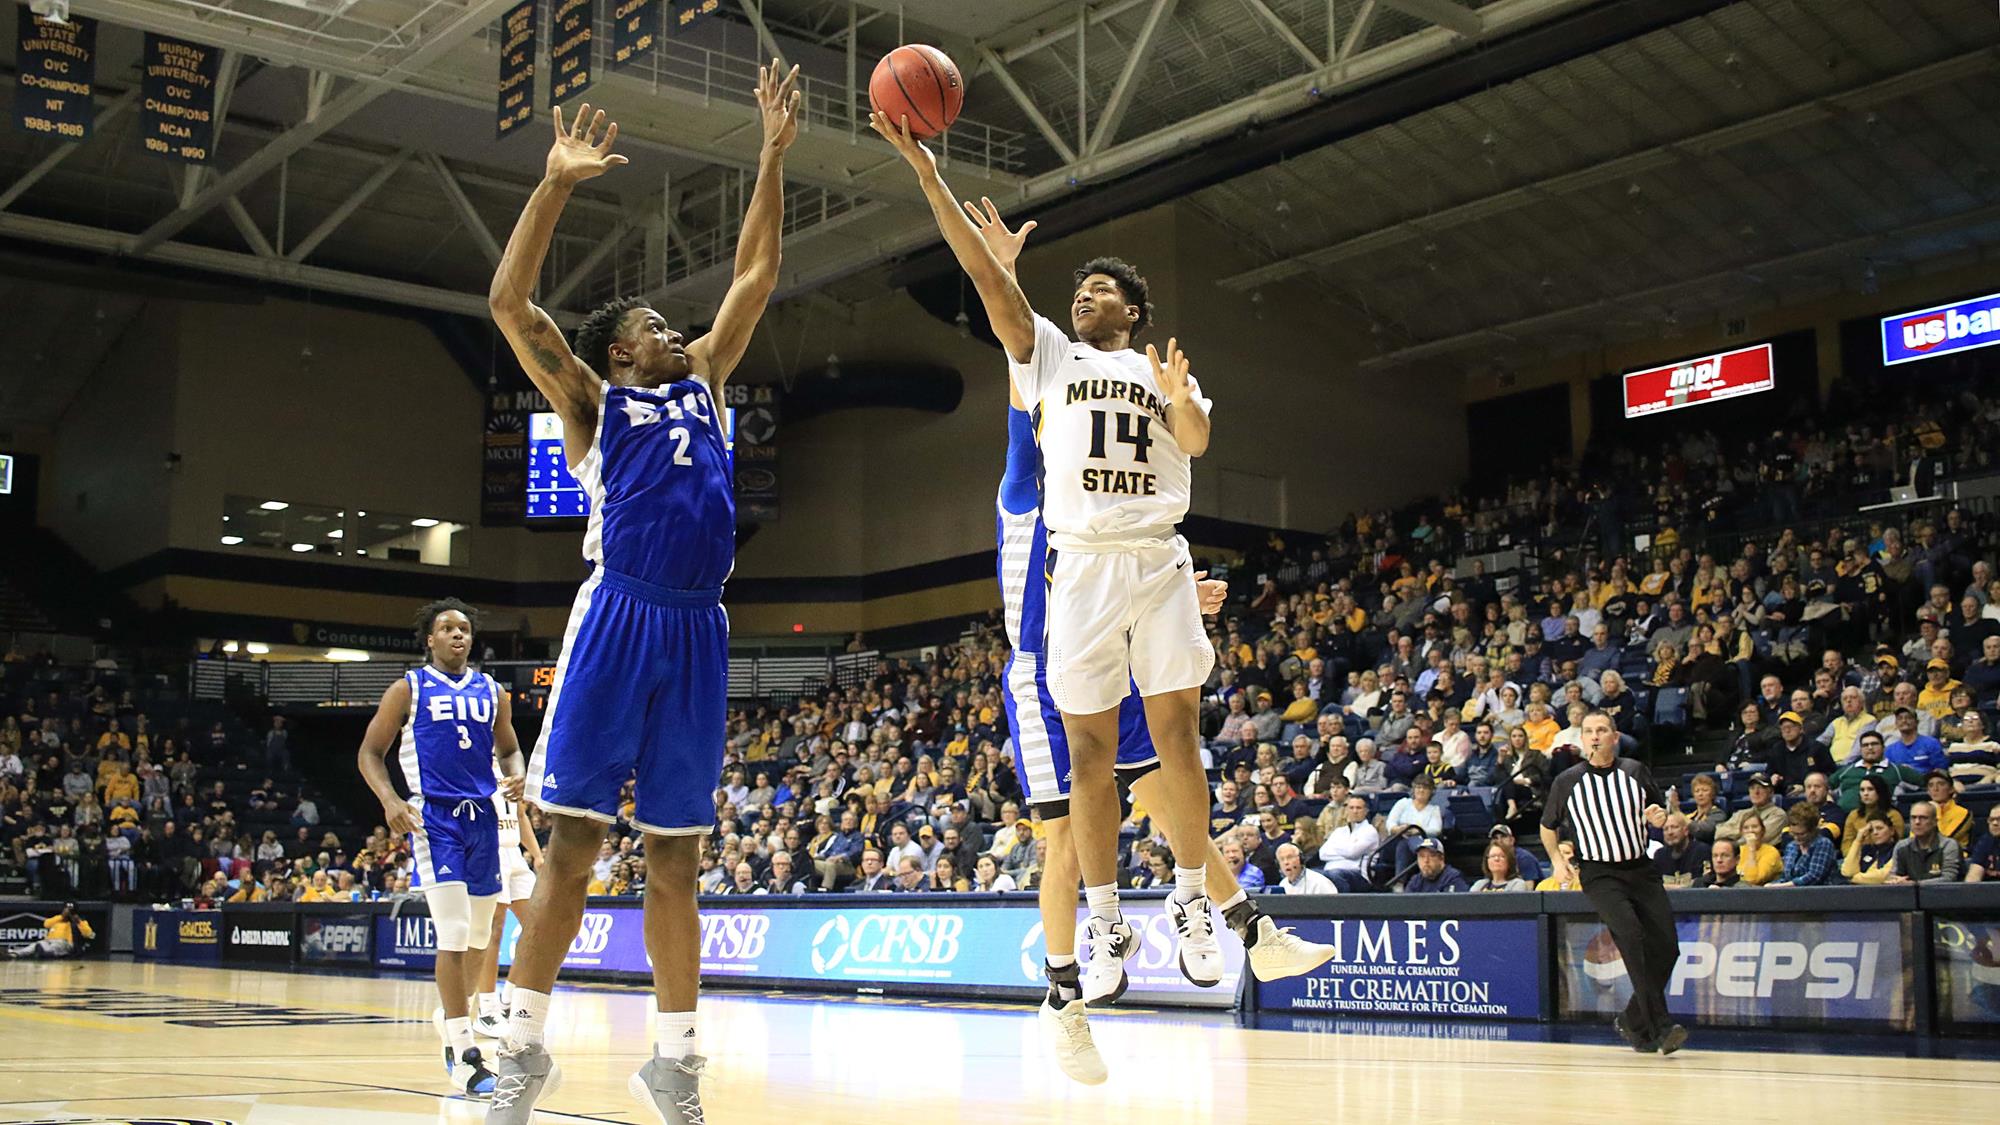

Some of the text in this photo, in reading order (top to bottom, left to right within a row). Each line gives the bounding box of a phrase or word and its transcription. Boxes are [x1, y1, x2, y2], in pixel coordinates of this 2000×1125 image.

[40, 27, 76, 43] STATE
[22, 39, 89, 62] UNIVERSITY
[158, 42, 205, 62] MURRAY
[44, 58, 69, 73] OVC
[163, 55, 198, 71] STATE
[148, 65, 211, 88] UNIVERSITY
[166, 85, 191, 99] OVC
[46, 99, 64, 112] NIT
[145, 98, 209, 122] CHAMPIONS
[159, 122, 192, 138] NCAA
[669, 426, 693, 466] 2
[1088, 409, 1153, 464] 14
[1082, 468, 1156, 496] STATE
[316, 628, 419, 648] Concessions
[426, 694, 490, 723] EIU
[457, 725, 473, 750] 3
[0, 928, 48, 940] ERVPR
[241, 929, 289, 946] DELTA DENTAL
[324, 925, 369, 952] PEPSI
[396, 917, 434, 948] IME
[570, 913, 613, 954] SB
[850, 914, 963, 964] CFSB
[1331, 919, 1460, 966] IMES
[1331, 965, 1460, 977] FUNERAL HOME & CREMATORY
[1669, 941, 1879, 1000] PEPSI
[1306, 977, 1490, 1003] PET CREMATION
[1335, 1000, 1372, 1010] TRUSTED
[1411, 1002, 1430, 1012] FOR
[1432, 1002, 1448, 1013] PET
